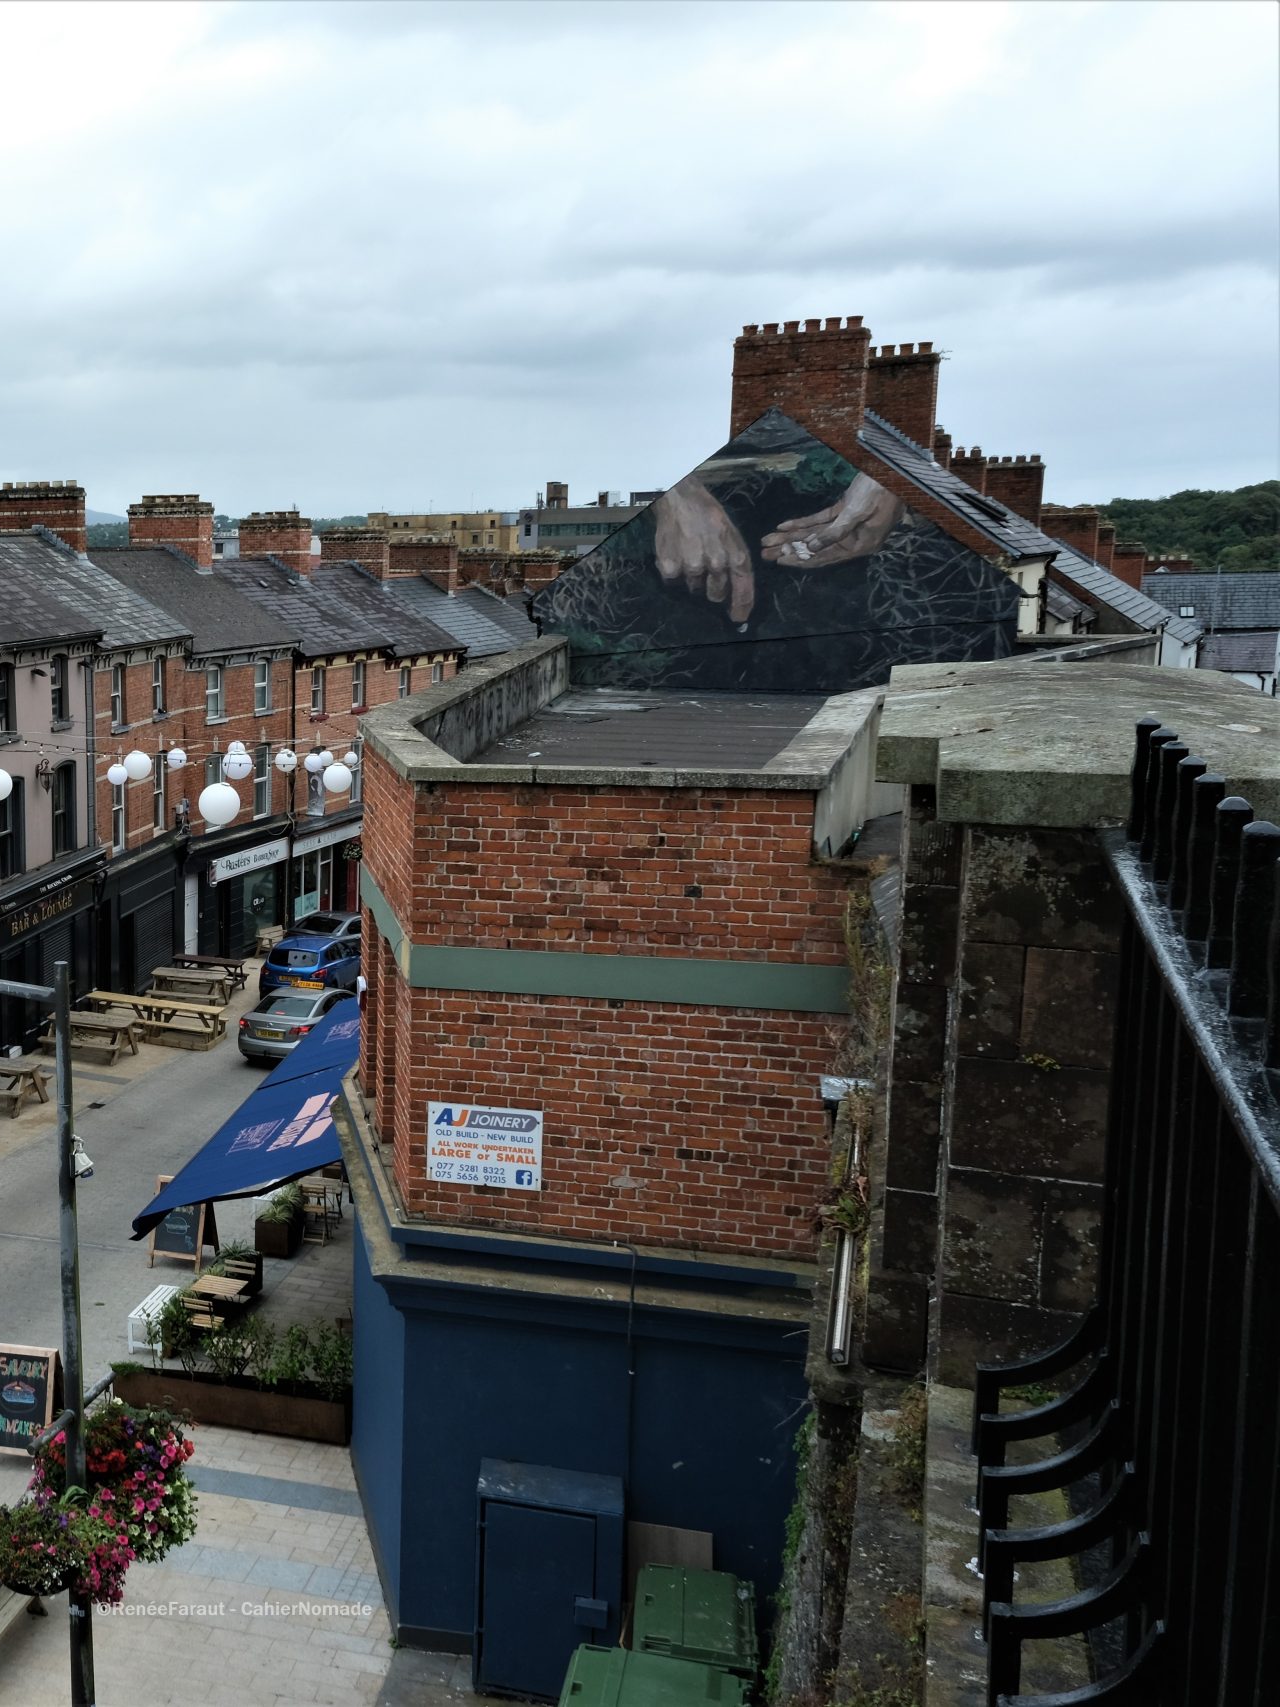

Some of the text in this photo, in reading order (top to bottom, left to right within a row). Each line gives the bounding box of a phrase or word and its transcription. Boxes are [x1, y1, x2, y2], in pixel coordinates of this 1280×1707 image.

[11, 896, 73, 937] BAR & LOUNGE
[434, 1107, 532, 1130] AJ JOINERY
[435, 1128, 452, 1138] OLD
[455, 1130, 479, 1140] BUILD
[486, 1132, 507, 1142] NEW
[510, 1134, 534, 1144] BUILD
[437, 1140, 535, 1155] ALL WORK UNDERTAKEN
[431, 1147, 538, 1165] LARGE or SMALL
[435, 1170, 452, 1179] 075
[456, 1171, 479, 1182] 5656
[436, 1161, 505, 1176] 077 5281 8322
